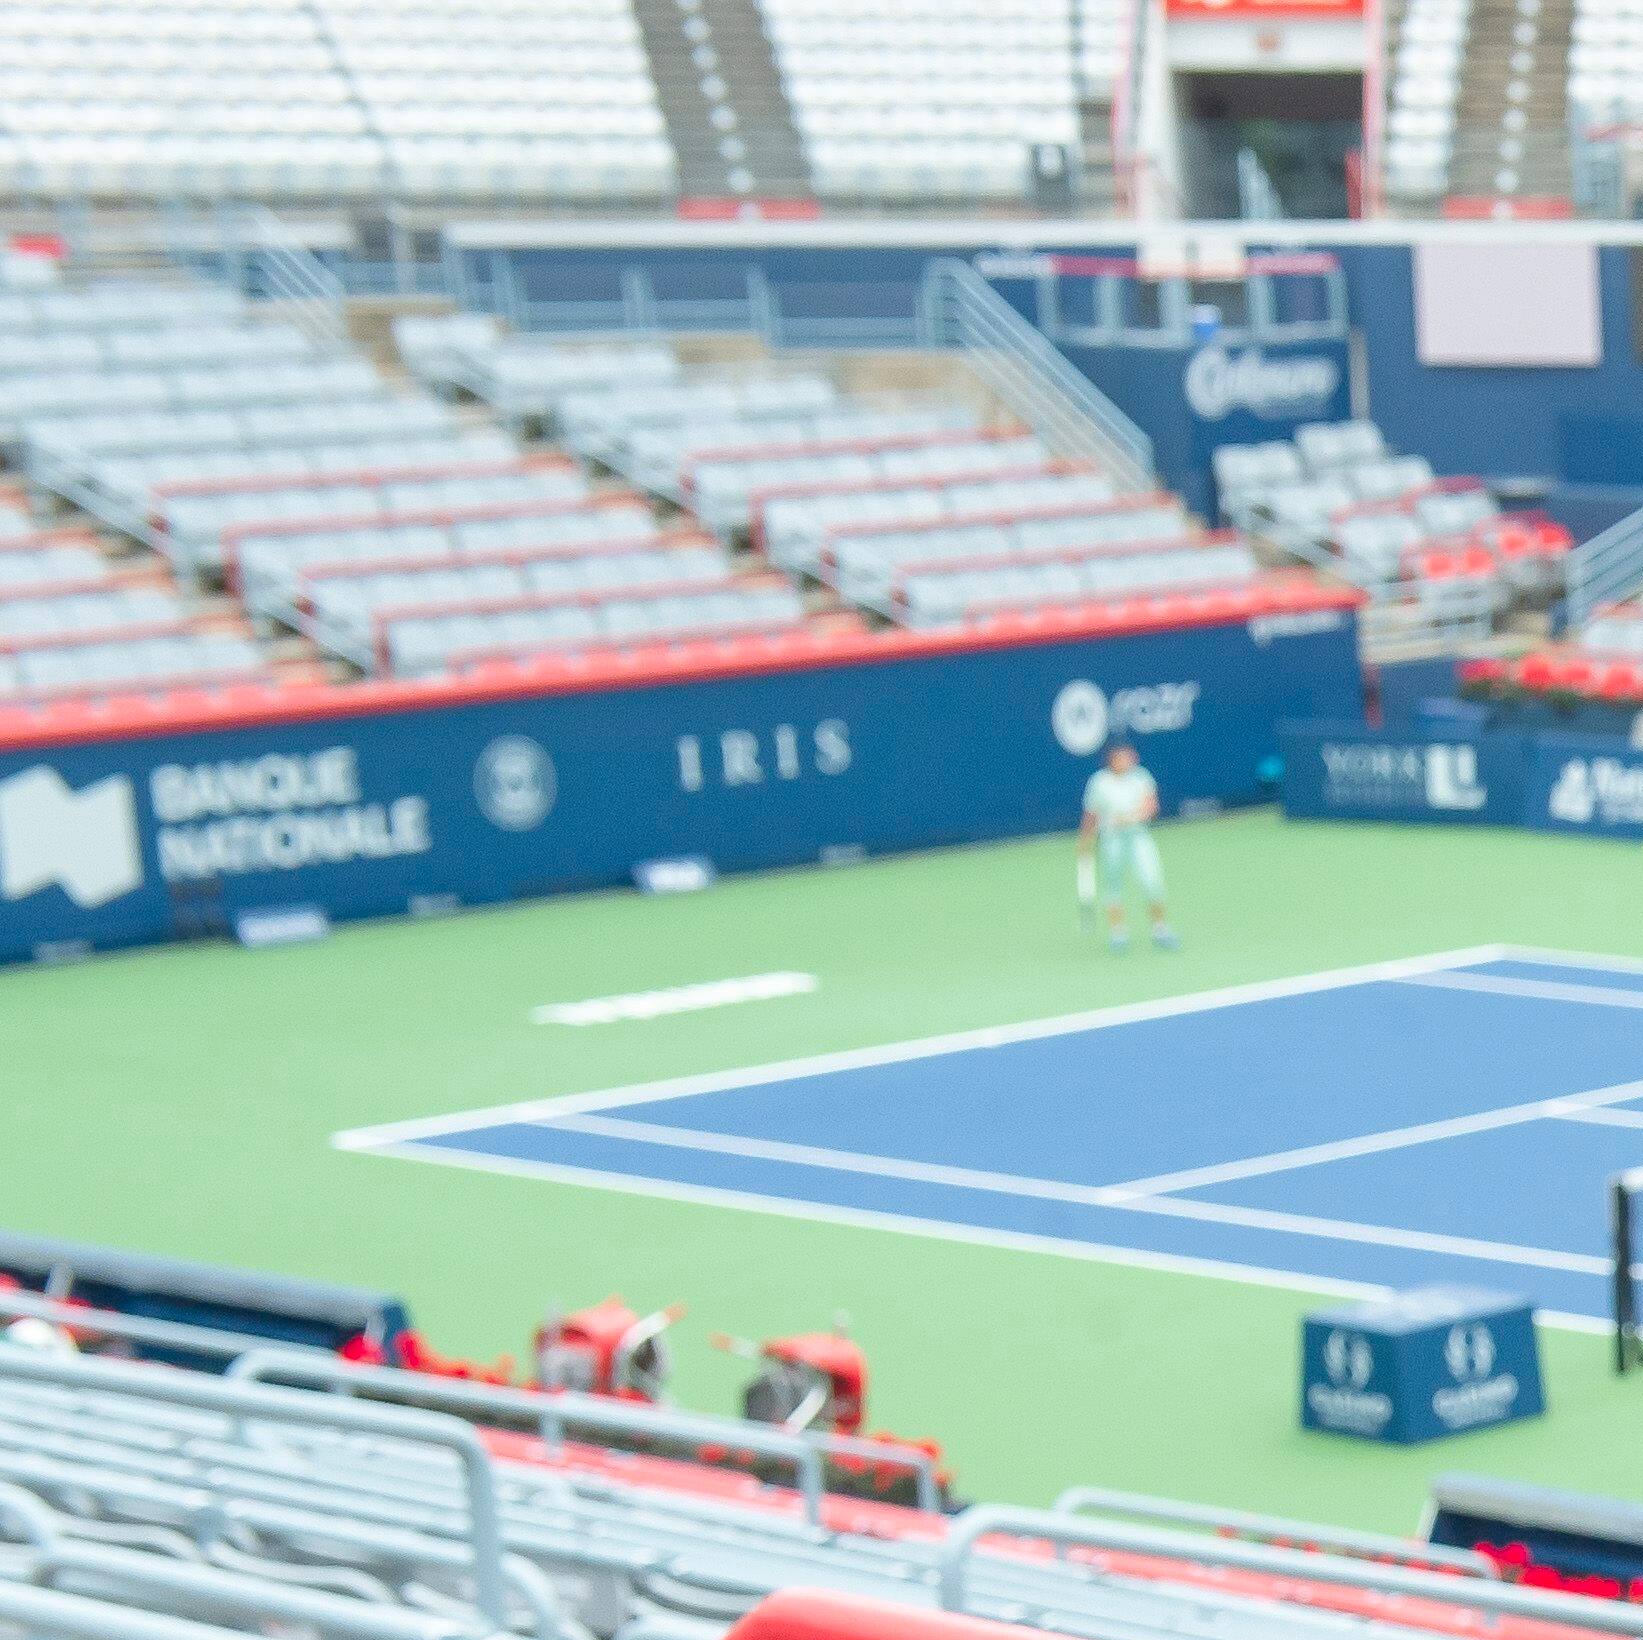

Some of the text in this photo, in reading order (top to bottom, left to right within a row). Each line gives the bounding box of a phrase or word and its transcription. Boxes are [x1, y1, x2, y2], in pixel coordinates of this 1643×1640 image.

[150, 746, 360, 821] BANQUE
[677, 719, 852, 791] IRIS
[157, 796, 431, 880] NATIONALE
